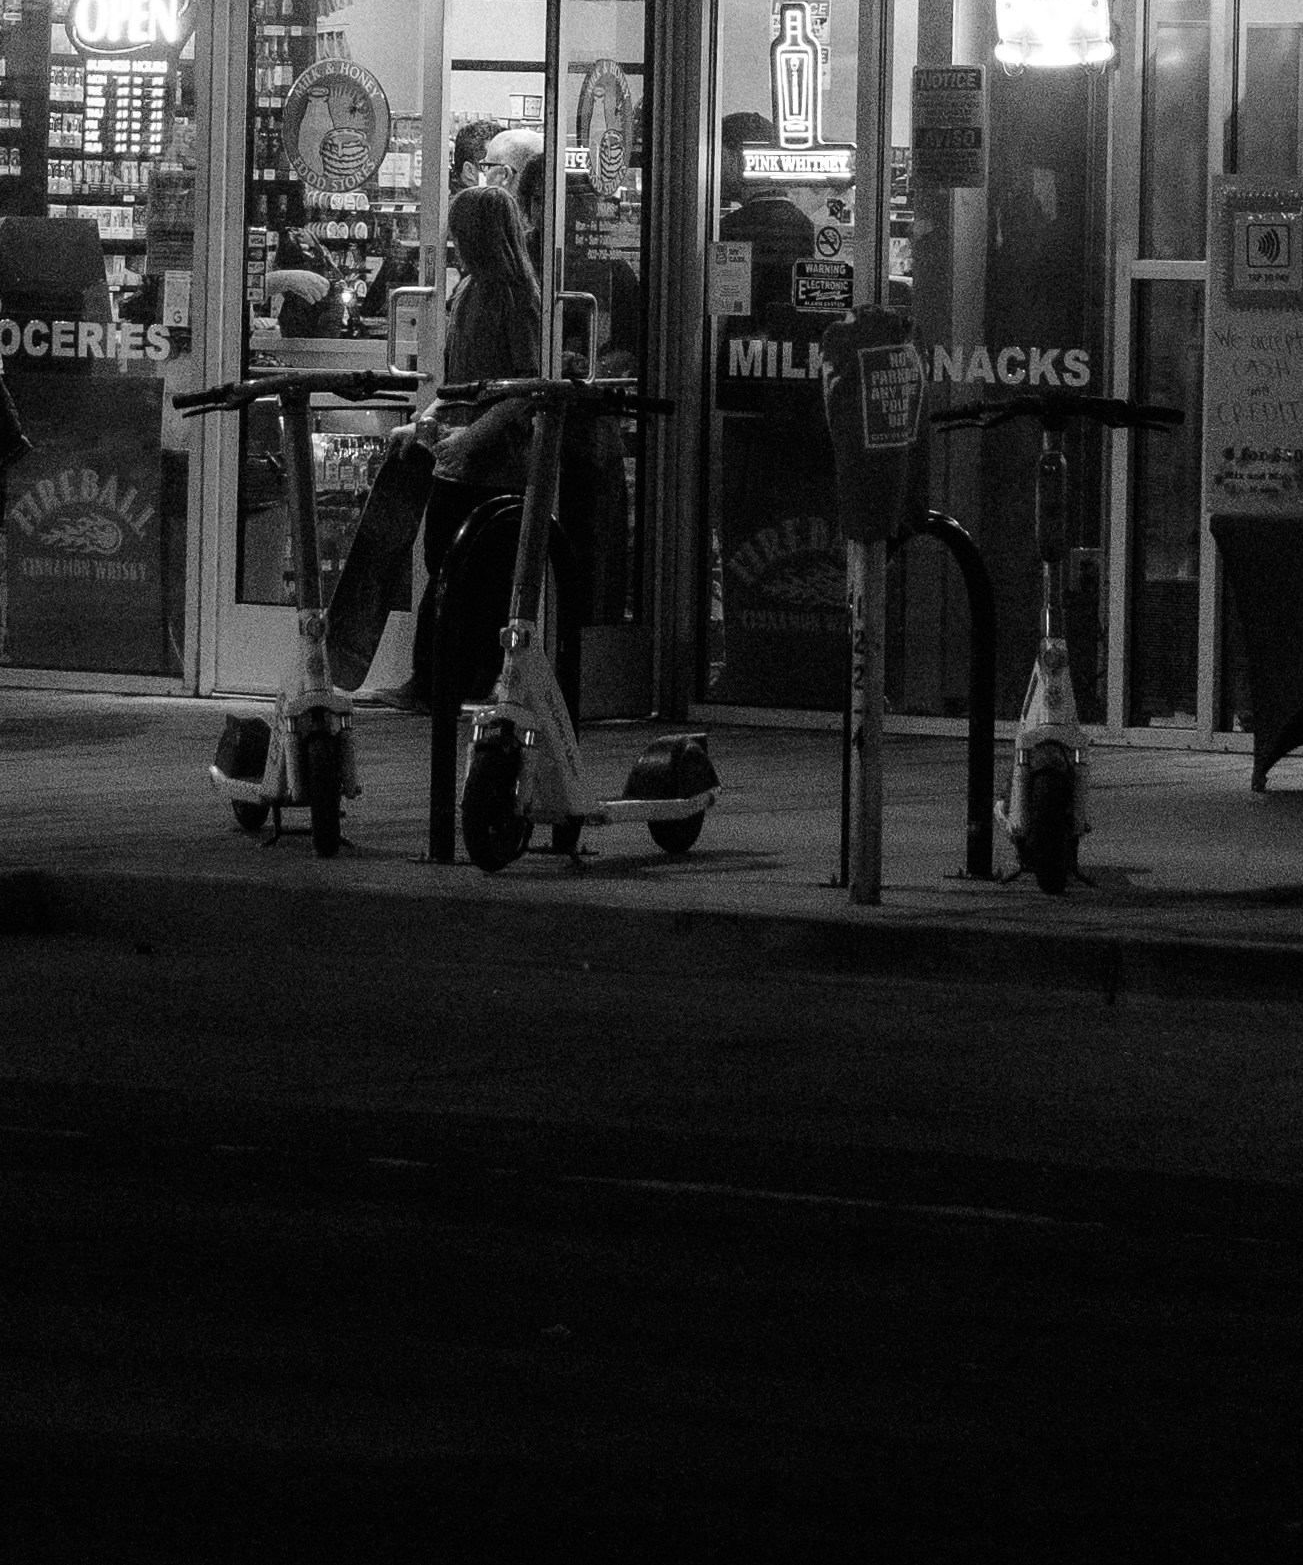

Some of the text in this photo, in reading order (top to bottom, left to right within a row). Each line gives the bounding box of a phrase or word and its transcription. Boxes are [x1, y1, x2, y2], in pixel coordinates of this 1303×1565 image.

[339, 62, 384, 99] HONEY
[745, 155, 850, 173] PINK WHITNEY
[805, 263, 846, 275] WARNING
[925, 344, 1091, 386] NACKS
[1233, 358, 1291, 378] CASH
[1217, 401, 1299, 425] CREDIT
[10, 467, 156, 539] FIREBALL
